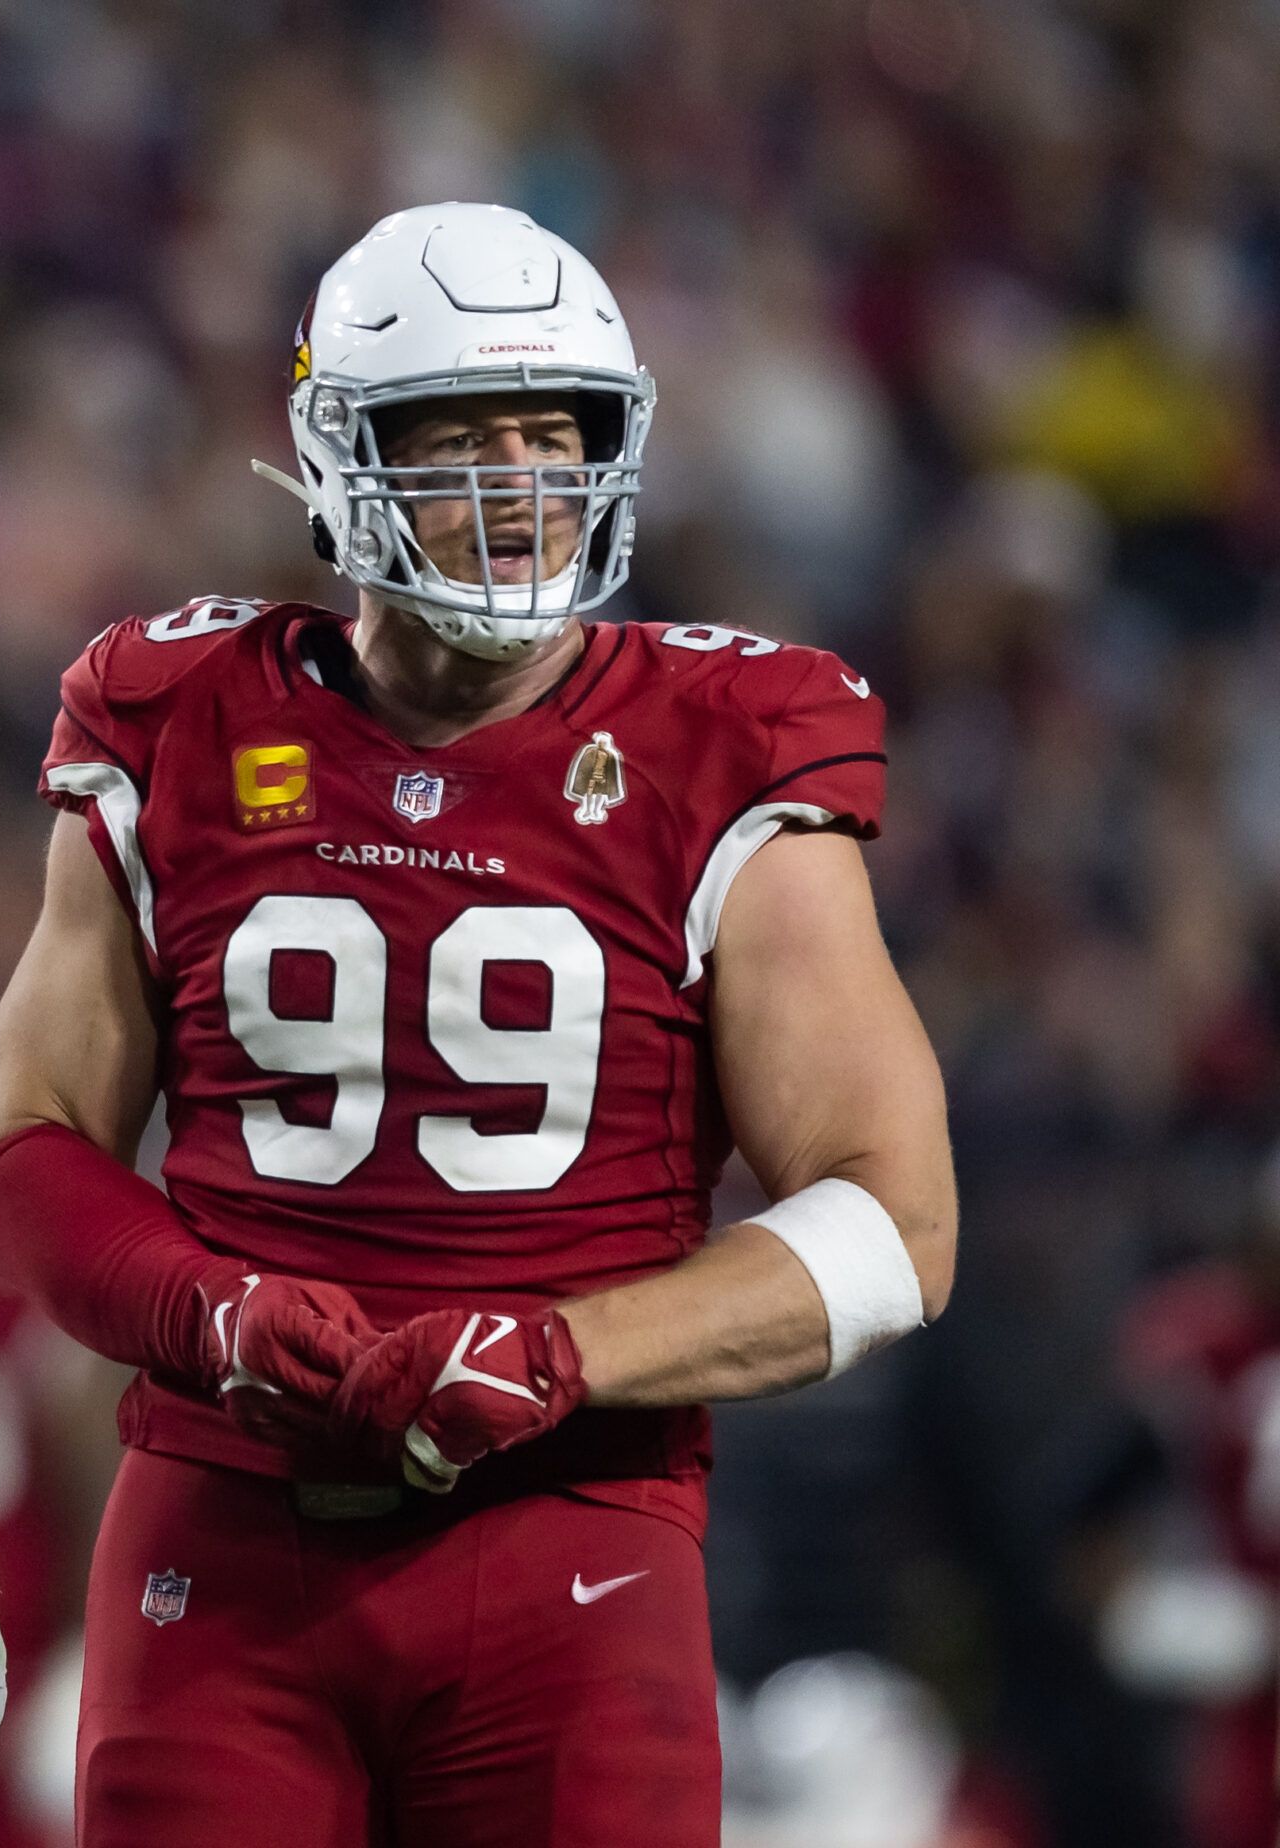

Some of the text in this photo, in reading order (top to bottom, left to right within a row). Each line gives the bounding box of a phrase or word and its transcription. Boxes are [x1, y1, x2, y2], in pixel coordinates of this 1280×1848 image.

[478, 344, 555, 354] CARDINALS
[236, 744, 307, 808] C
[316, 843, 506, 875] CARDINALS
[223, 895, 606, 1192] 99
